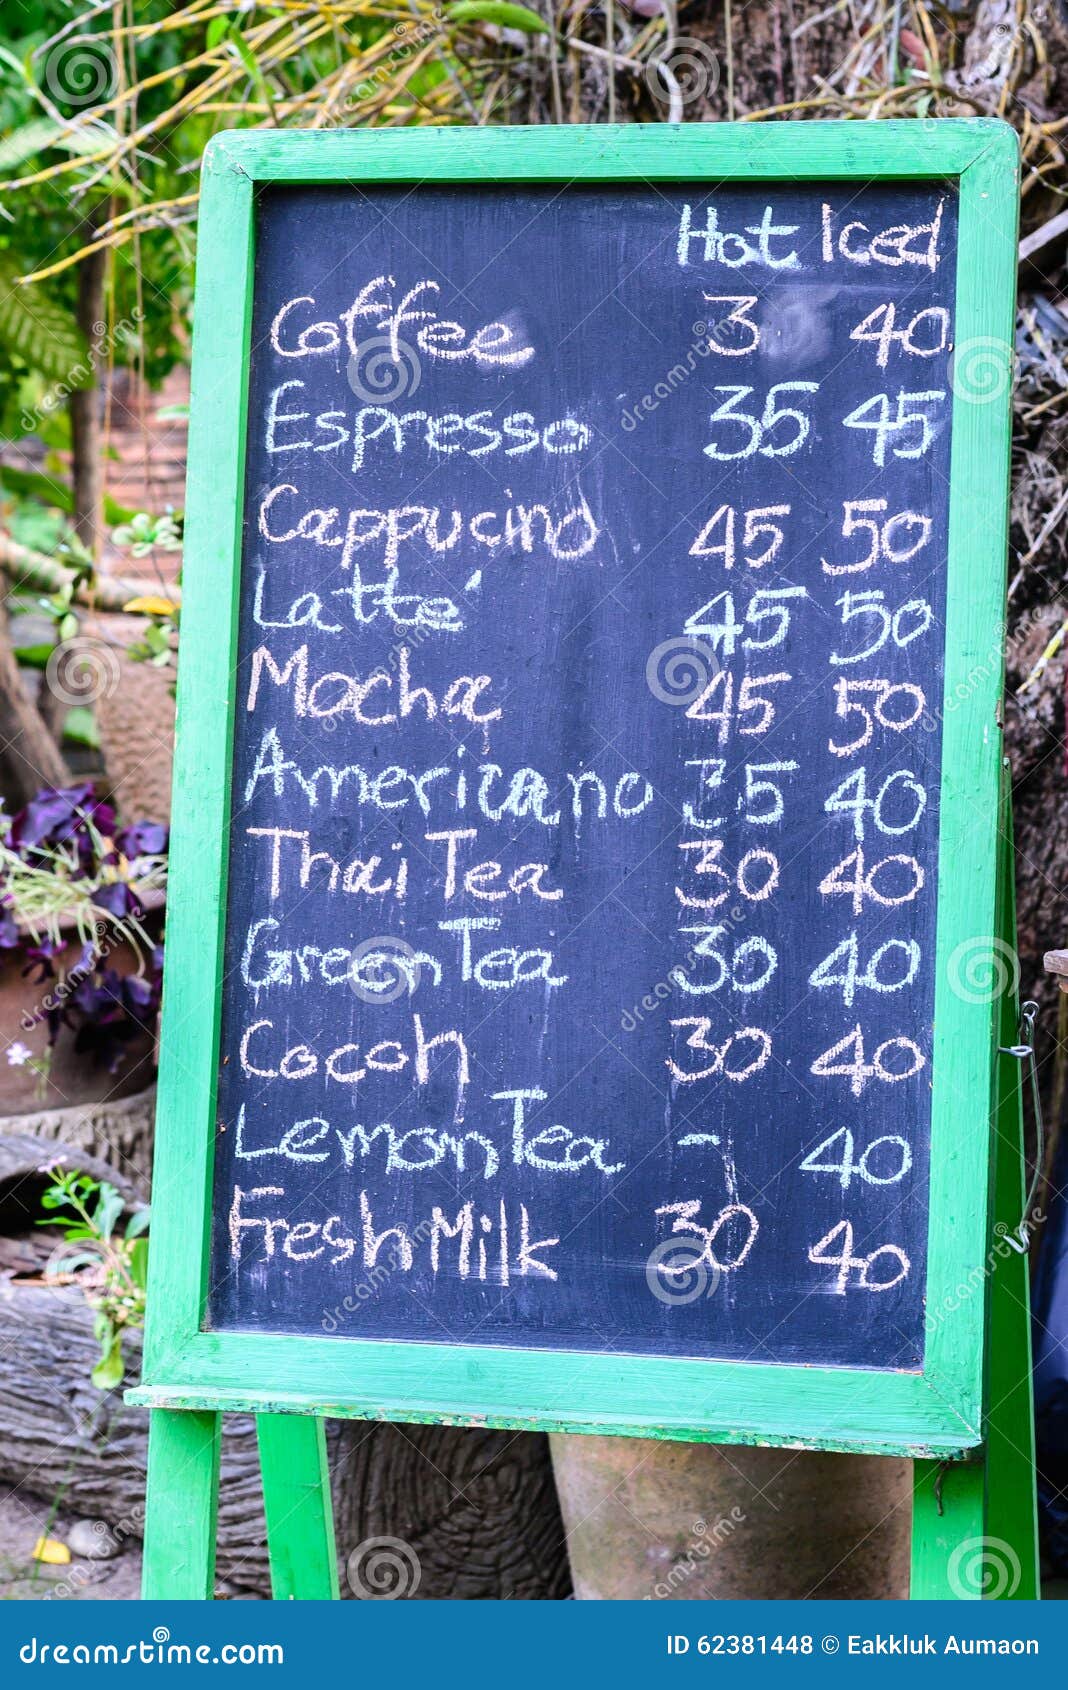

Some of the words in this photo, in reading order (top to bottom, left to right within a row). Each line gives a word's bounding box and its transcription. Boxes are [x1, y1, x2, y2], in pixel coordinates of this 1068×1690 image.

[676, 204, 800, 270] Hot
[822, 197, 948, 273] Iced
[270, 275, 536, 364] Coffee
[849, 302, 951, 367] 40
[265, 380, 593, 473] Espresso
[702, 381, 820, 461] 35
[842, 390, 946, 467] 45
[258, 484, 602, 569] Cappucino
[689, 504, 790, 569] 45
[820, 499, 932, 576] 50
[683, 586, 806, 656] 45
[829, 589, 932, 665] 50
[247, 645, 502, 725] Mocha
[685, 670, 792, 745] 45
[828, 677, 926, 757] 50
[243, 727, 653, 825] Americano
[683, 759, 800, 829] 35
[824, 766, 927, 842] 40
[247, 826, 408, 899] Thai
[425, 828, 563, 900] Tea
[675, 840, 780, 908] 30
[818, 844, 924, 916] 40
[241, 918, 441, 996] Green
[438, 917, 568, 990] Tea
[673, 925, 778, 994] 30
[809, 930, 921, 1007] 40
[665, 1016, 772, 1082] 30
[810, 1023, 926, 1097] 40
[234, 1103, 499, 1179] Lemon
[491, 1089, 626, 1174] Tea
[799, 1126, 913, 1188] 40
[229, 1184, 412, 1271] Fresh
[430, 1199, 559, 1286] Milk
[654, 1200, 760, 1274] 30
[808, 1220, 911, 1295] 40
